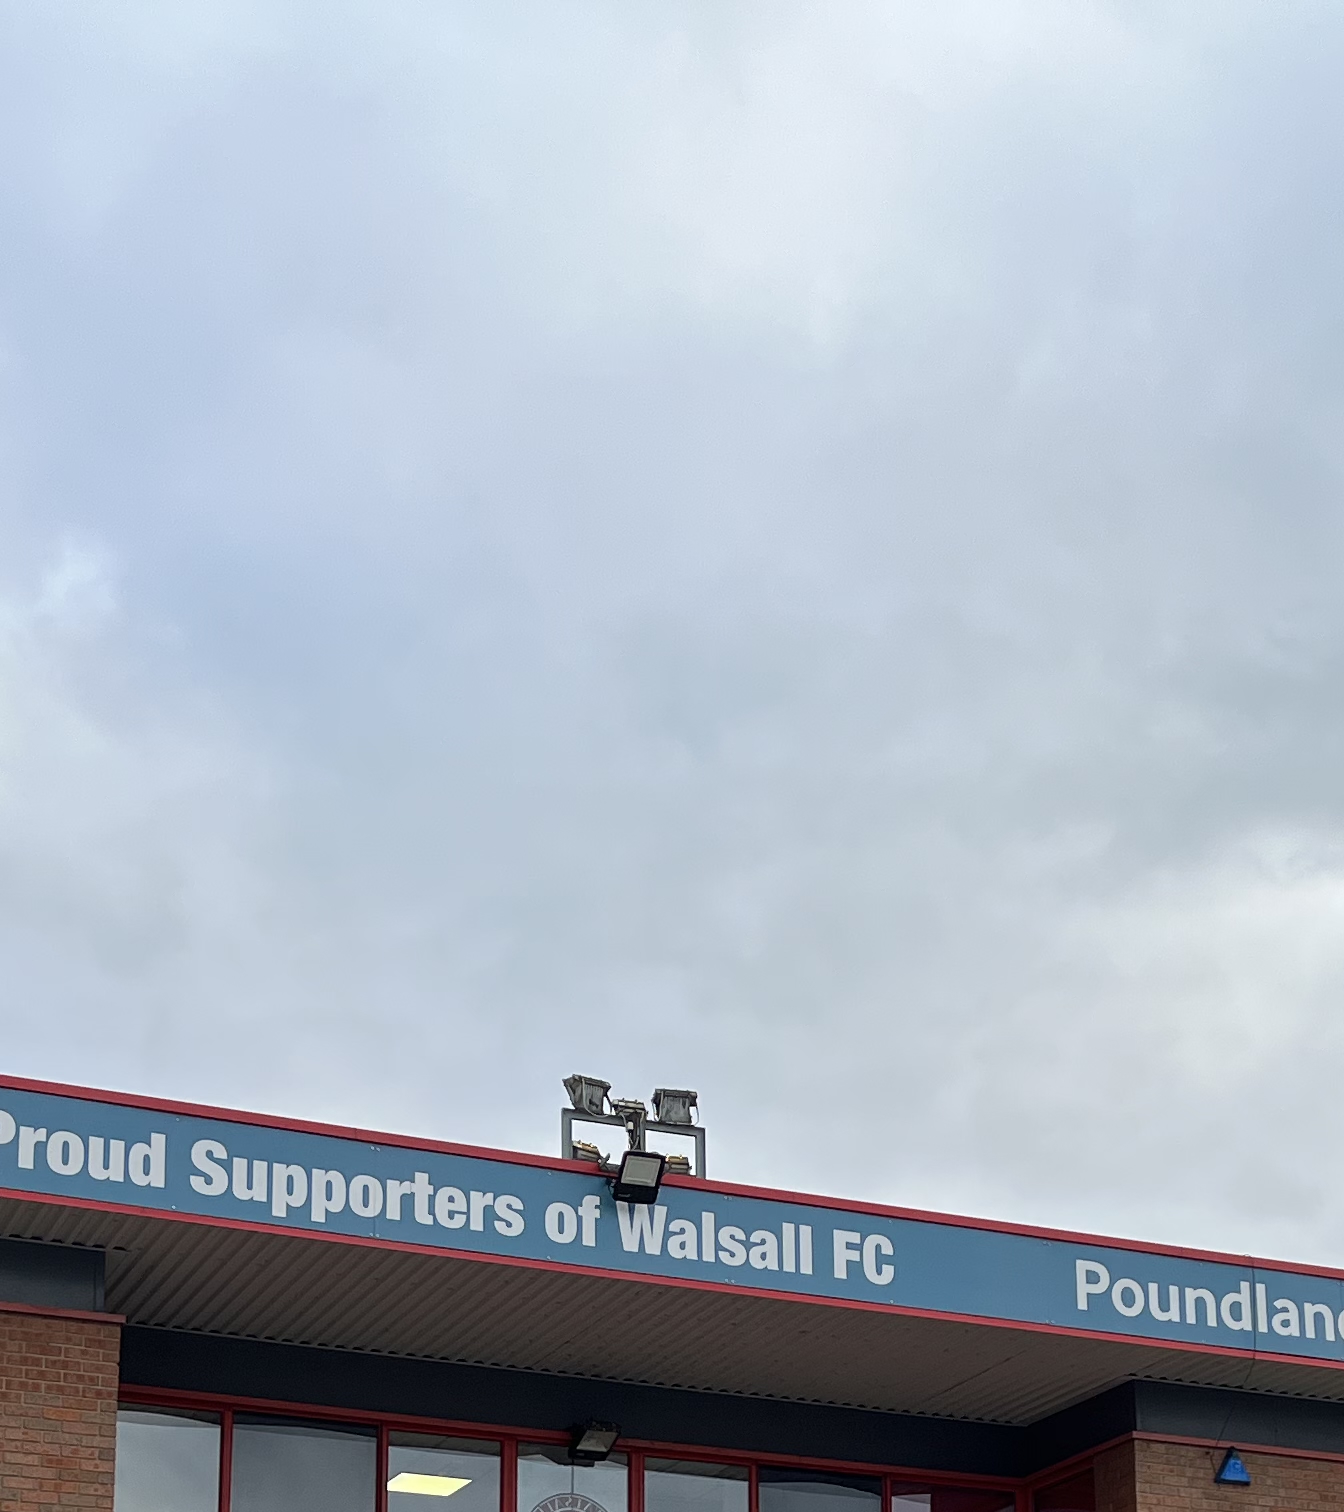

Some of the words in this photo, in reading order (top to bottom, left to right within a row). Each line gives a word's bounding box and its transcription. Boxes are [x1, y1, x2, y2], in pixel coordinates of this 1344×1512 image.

[189, 1138, 525, 1237] Supporters
[544, 1195, 601, 1247] of
[616, 1201, 813, 1275] Walsall
[833, 1229, 895, 1285] FC
